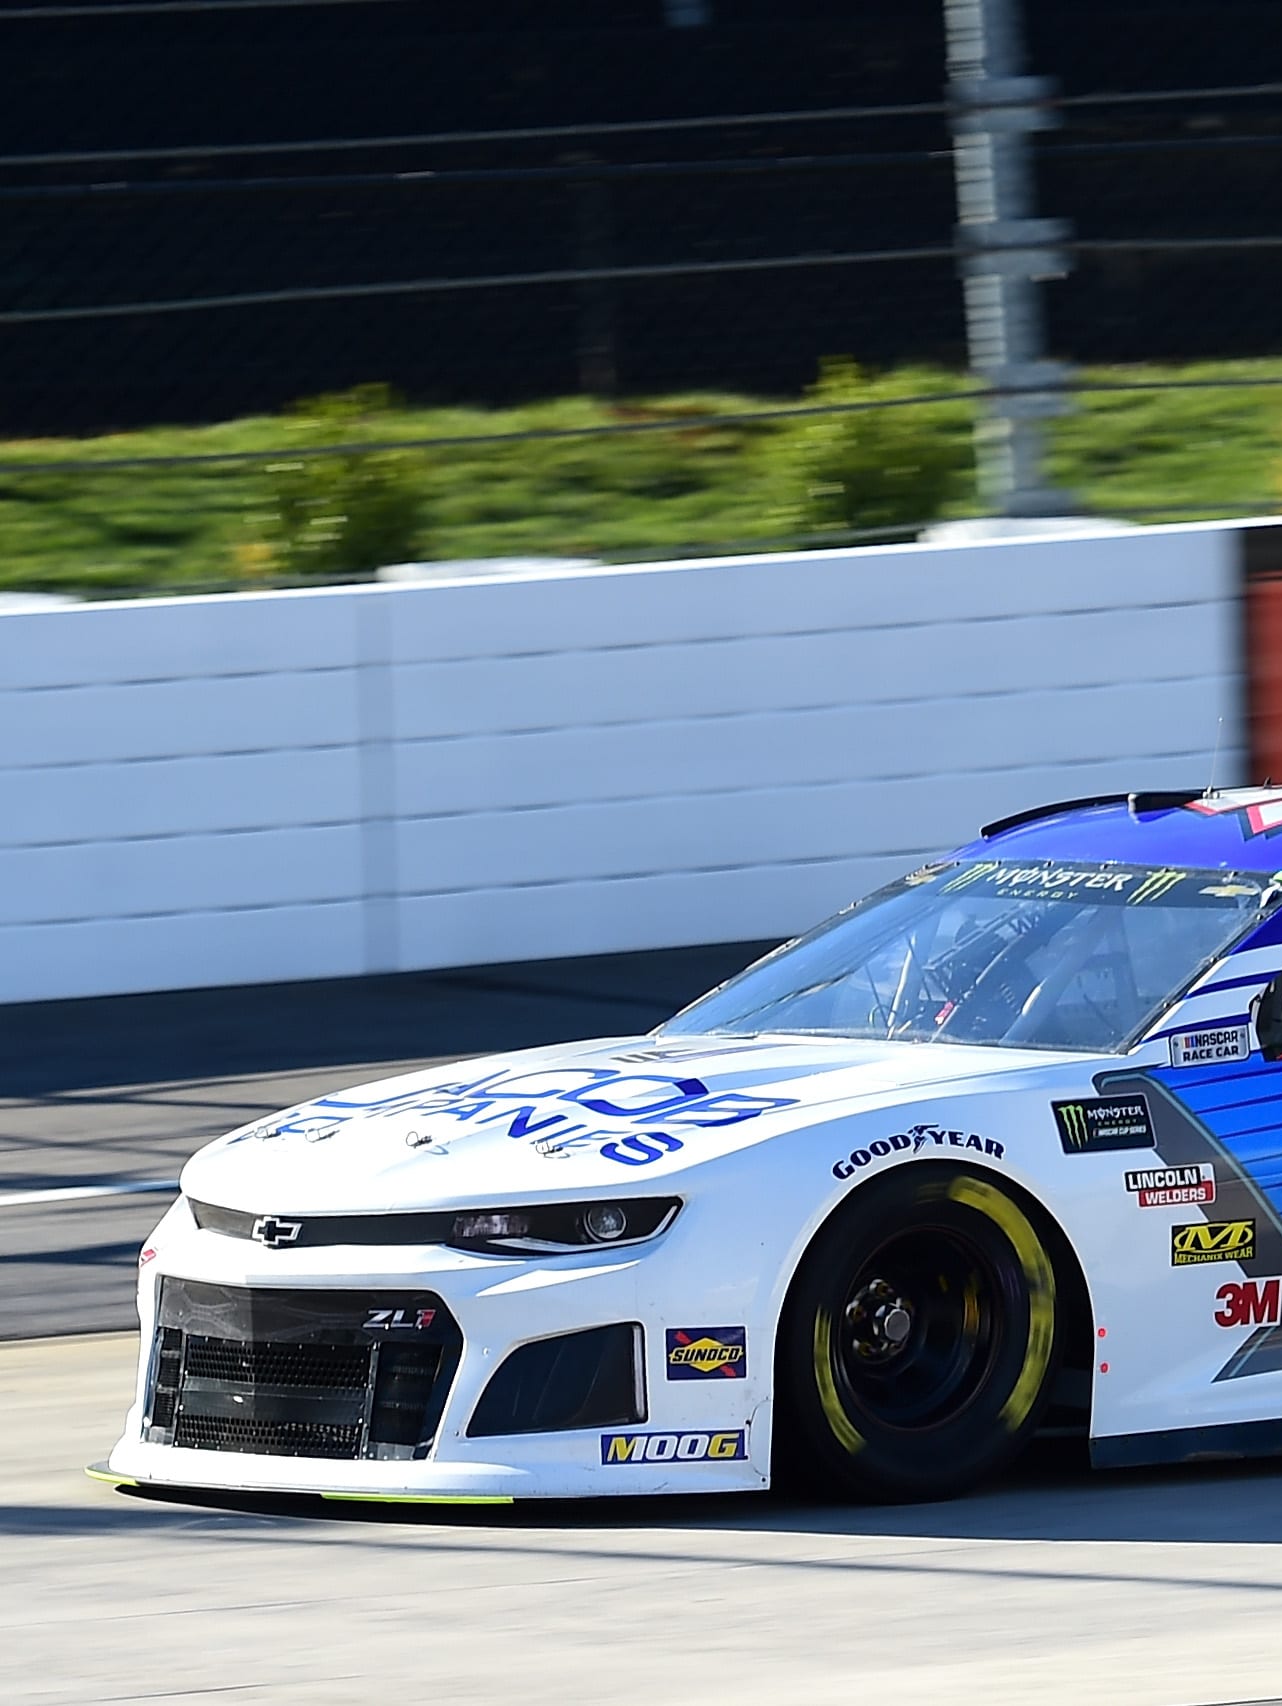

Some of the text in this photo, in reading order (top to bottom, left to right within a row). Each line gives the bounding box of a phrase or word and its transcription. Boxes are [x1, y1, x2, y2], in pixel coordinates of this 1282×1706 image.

[997, 888, 1079, 899] ENERGY
[1195, 1030, 1239, 1048] NASCAR
[1183, 1045, 1239, 1062] RACE CAR
[1127, 1168, 1198, 1190] LINCOLN
[1145, 1187, 1207, 1205] WELDERS
[1174, 1247, 1253, 1265] MECHANIX WEAR
[1214, 1280, 1280, 1328] 3M
[362, 1309, 436, 1328] ZL1
[671, 1347, 741, 1363] SUNOCO
[606, 1433, 740, 1462] MOOG
